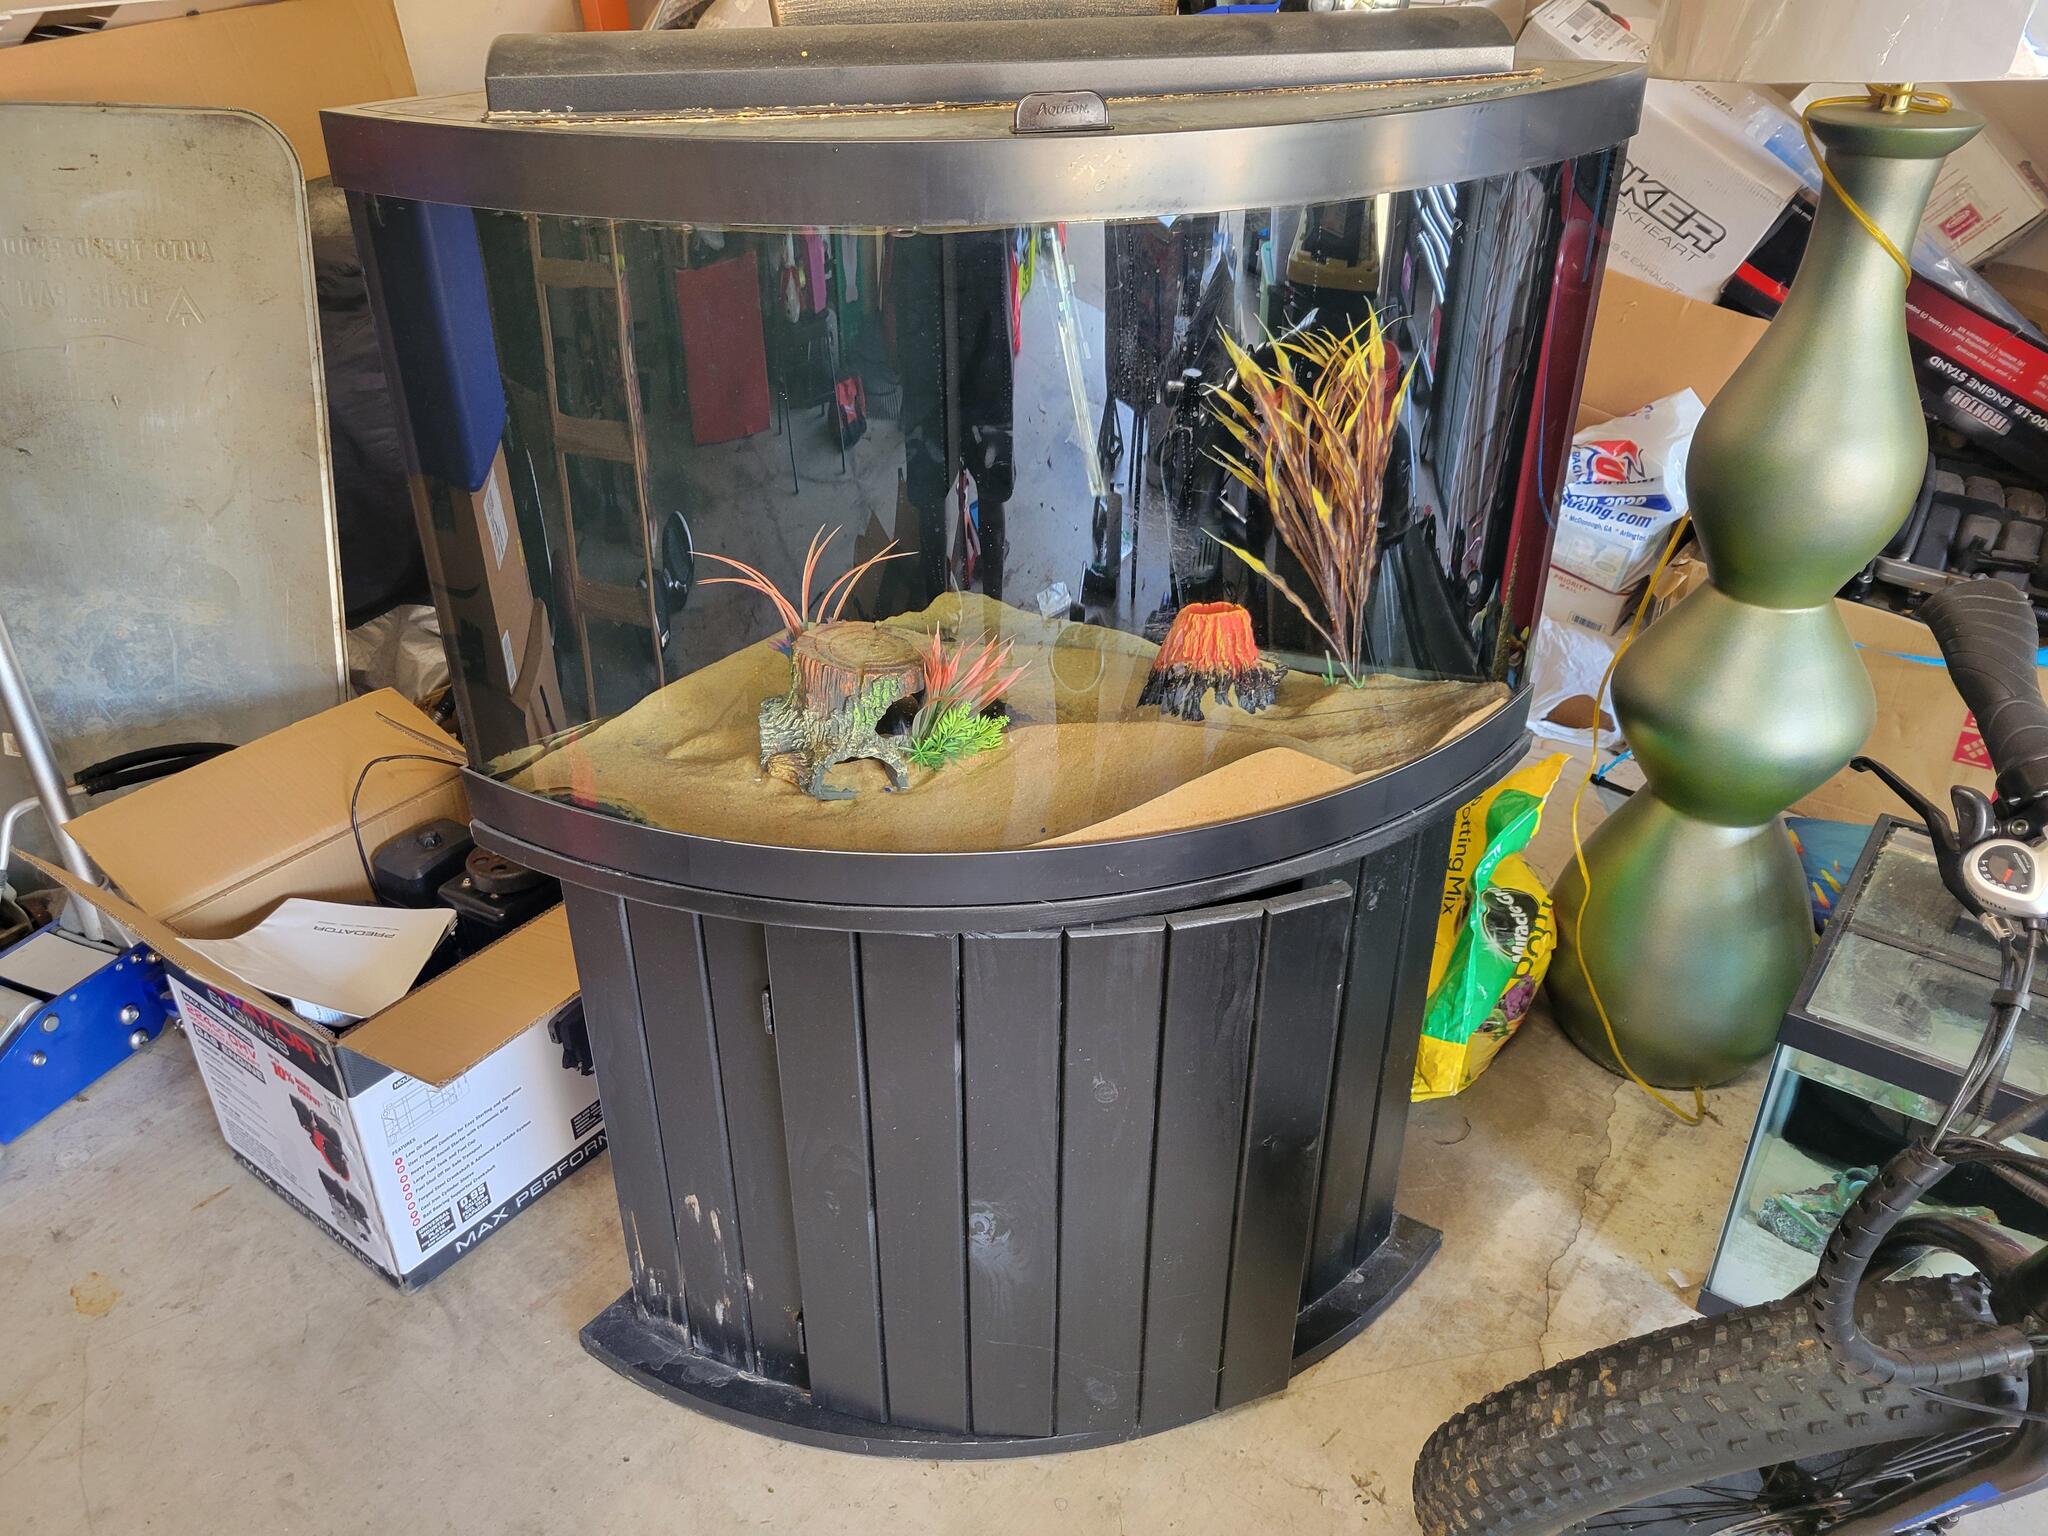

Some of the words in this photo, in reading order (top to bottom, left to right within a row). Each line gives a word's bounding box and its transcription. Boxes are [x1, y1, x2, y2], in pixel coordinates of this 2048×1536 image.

[1616, 200, 1701, 262] CKHEART
[1929, 355, 1969, 382] STAND
[1967, 377, 2013, 407] ENGINE
[1950, 391, 2009, 431] IRONTON
[2015, 402, 2048, 431] 00-LB.
[1563, 498, 1653, 528] acing.com
[1553, 573, 1588, 592] PRIORITY
[1442, 876, 1466, 915] Mix
[313, 925, 396, 939] PREDATOR
[207, 989, 290, 1056] ENGINES
[194, 1024, 219, 1048] GAS
[221, 1044, 263, 1081] ENGINE
[227, 1033, 256, 1059] OHV
[271, 1061, 295, 1084] 10%
[460, 1184, 486, 1208] 0.95
[241, 1158, 273, 1189] MAX
[276, 1186, 381, 1273] PERFORMANCE
[455, 1206, 509, 1254] MAX
